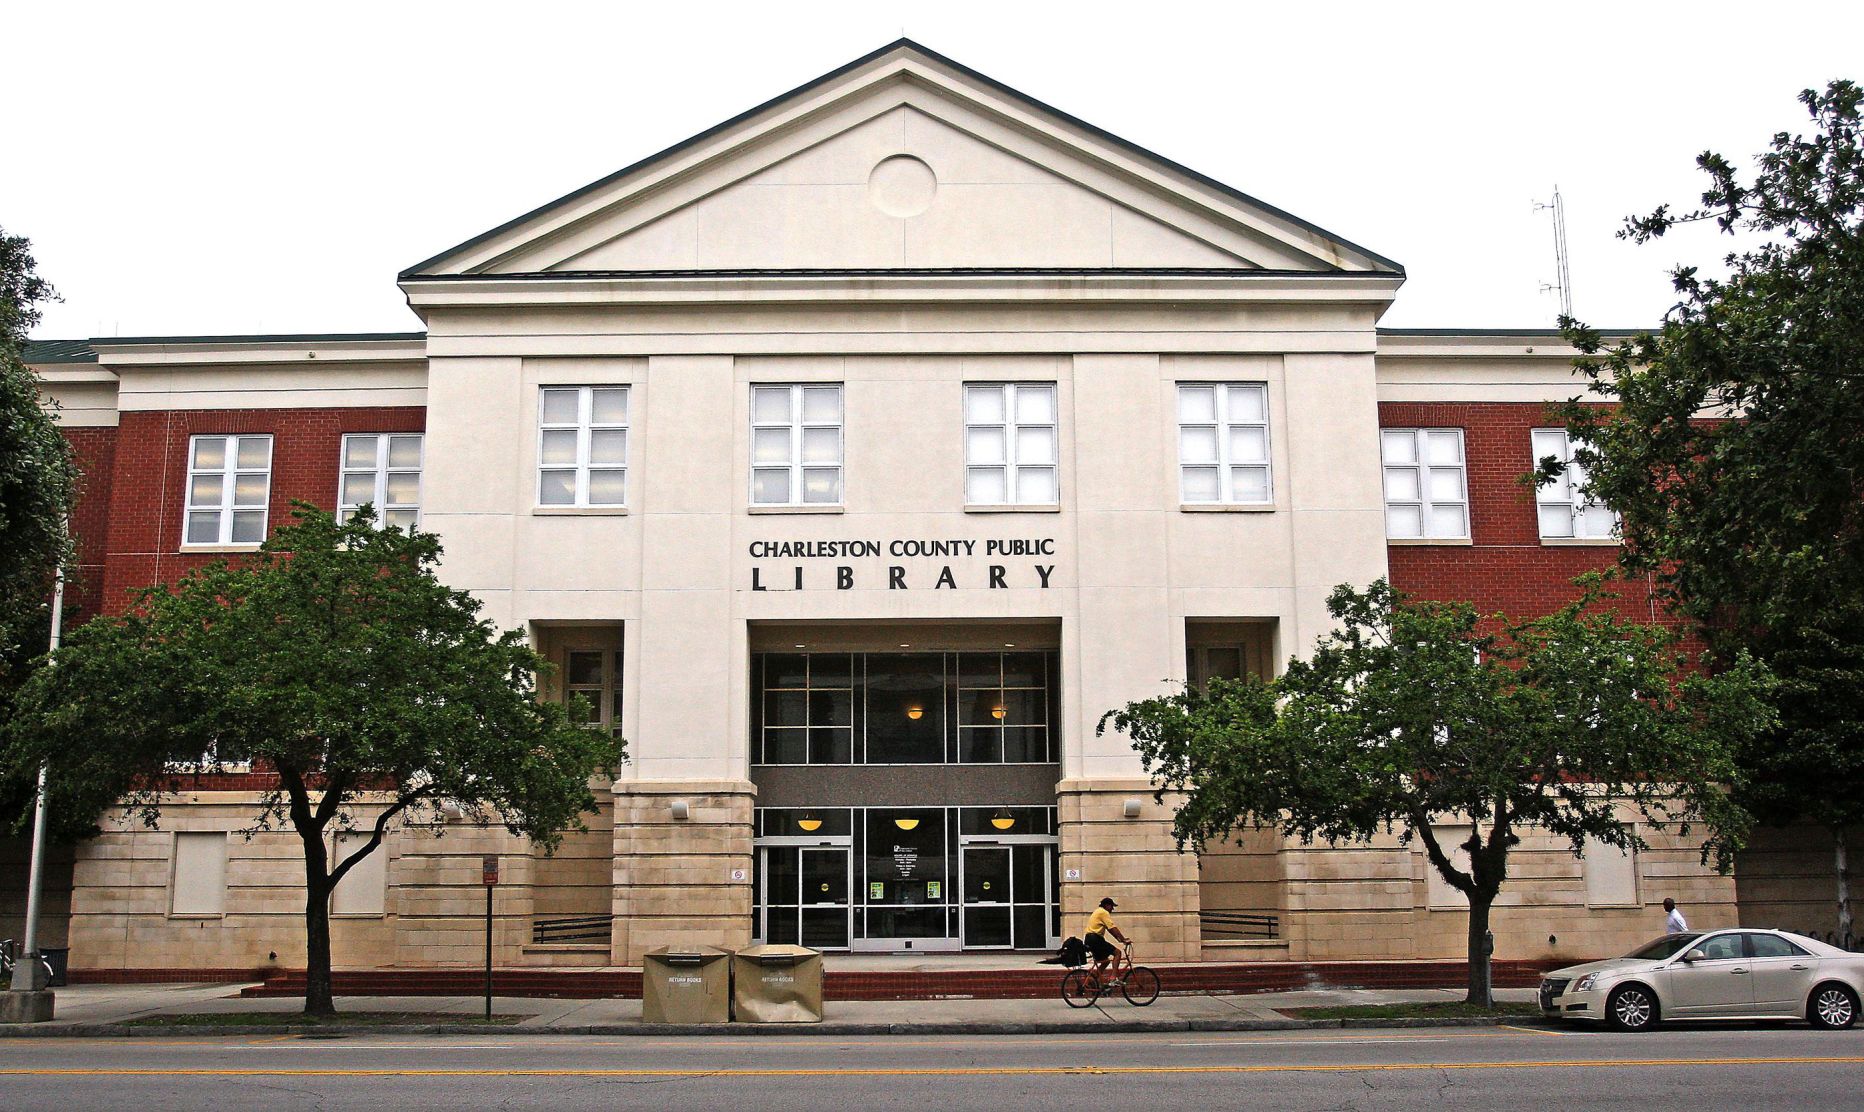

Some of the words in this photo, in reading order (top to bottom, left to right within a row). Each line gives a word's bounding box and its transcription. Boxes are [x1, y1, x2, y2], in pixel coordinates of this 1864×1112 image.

[749, 541, 881, 558] CHARLESTON
[889, 540, 976, 557] COUNTY
[987, 539, 1055, 556] PUBLIC
[752, 565, 1055, 591] LIBRARY
